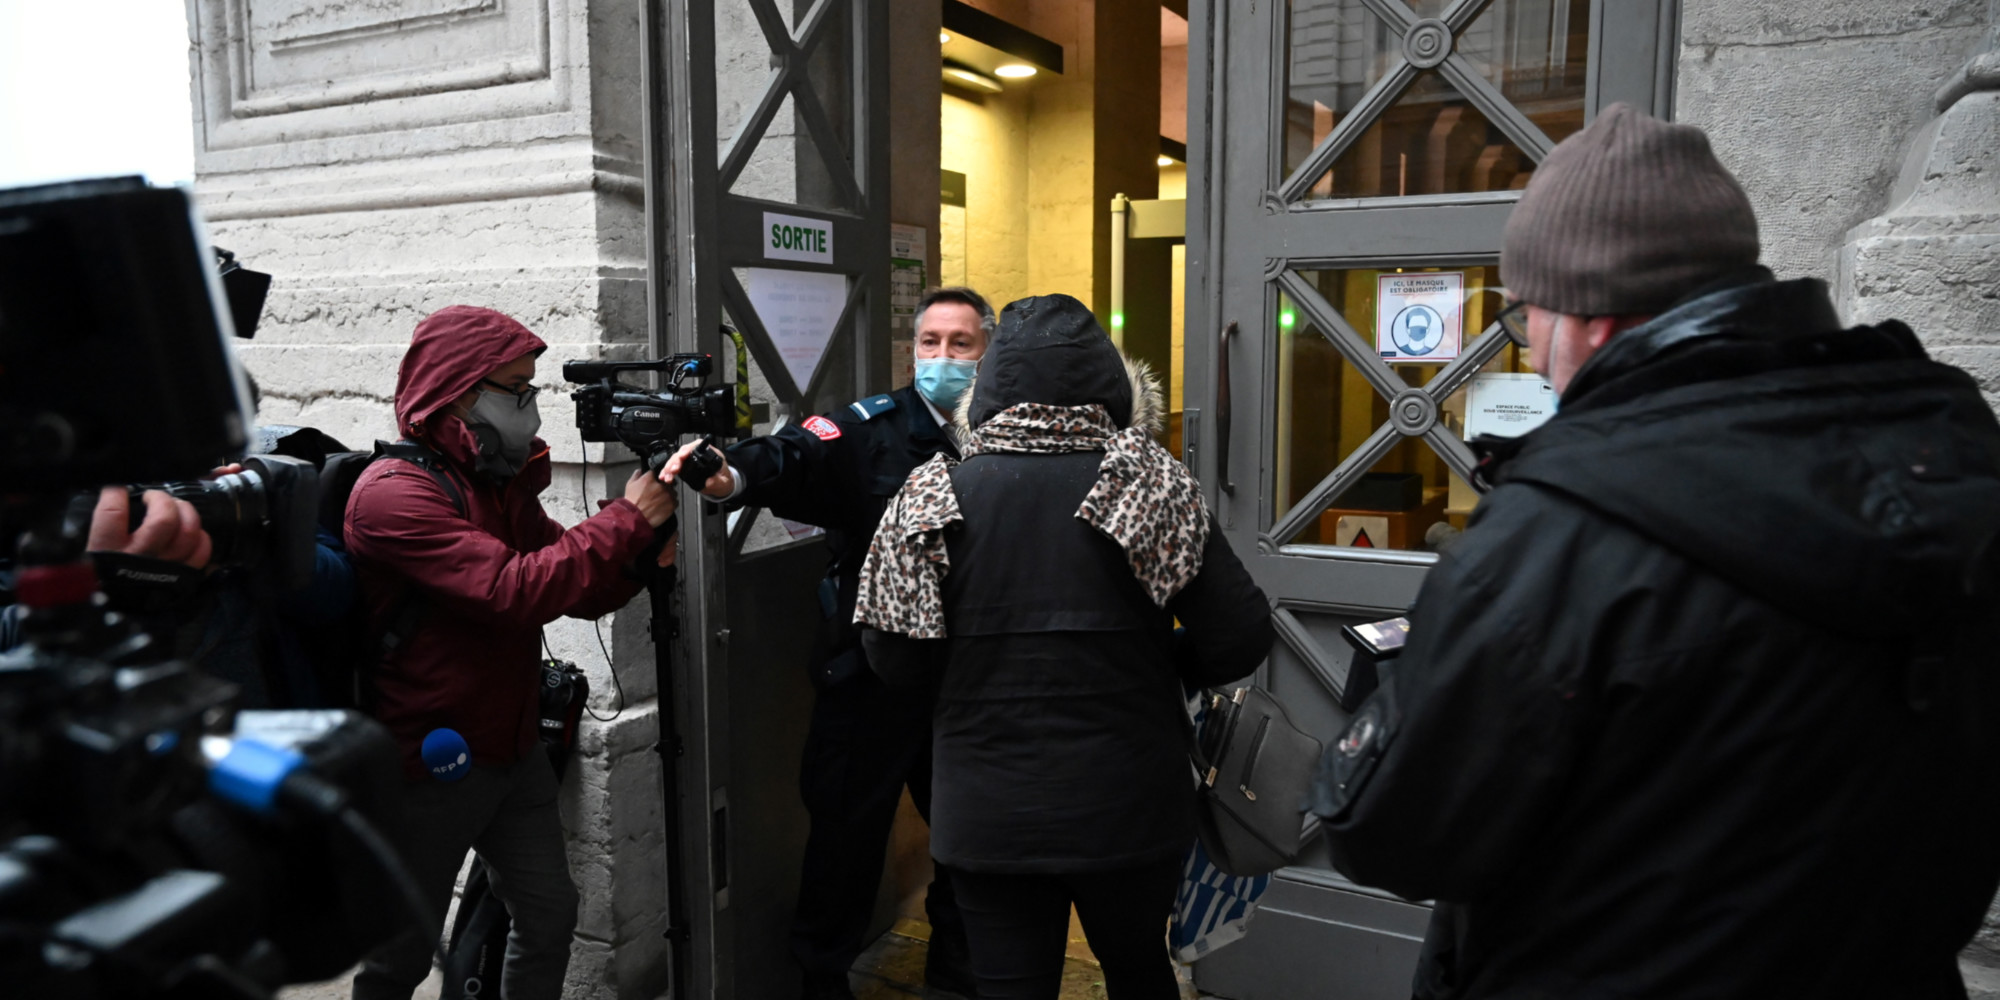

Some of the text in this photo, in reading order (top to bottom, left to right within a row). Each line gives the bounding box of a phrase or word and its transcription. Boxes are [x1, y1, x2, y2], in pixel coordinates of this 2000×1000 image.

[772, 223, 826, 253] SORTIE
[634, 410, 660, 418] Canon
[116, 568, 180, 583] FUJINON
[433, 763, 456, 773] AFP
